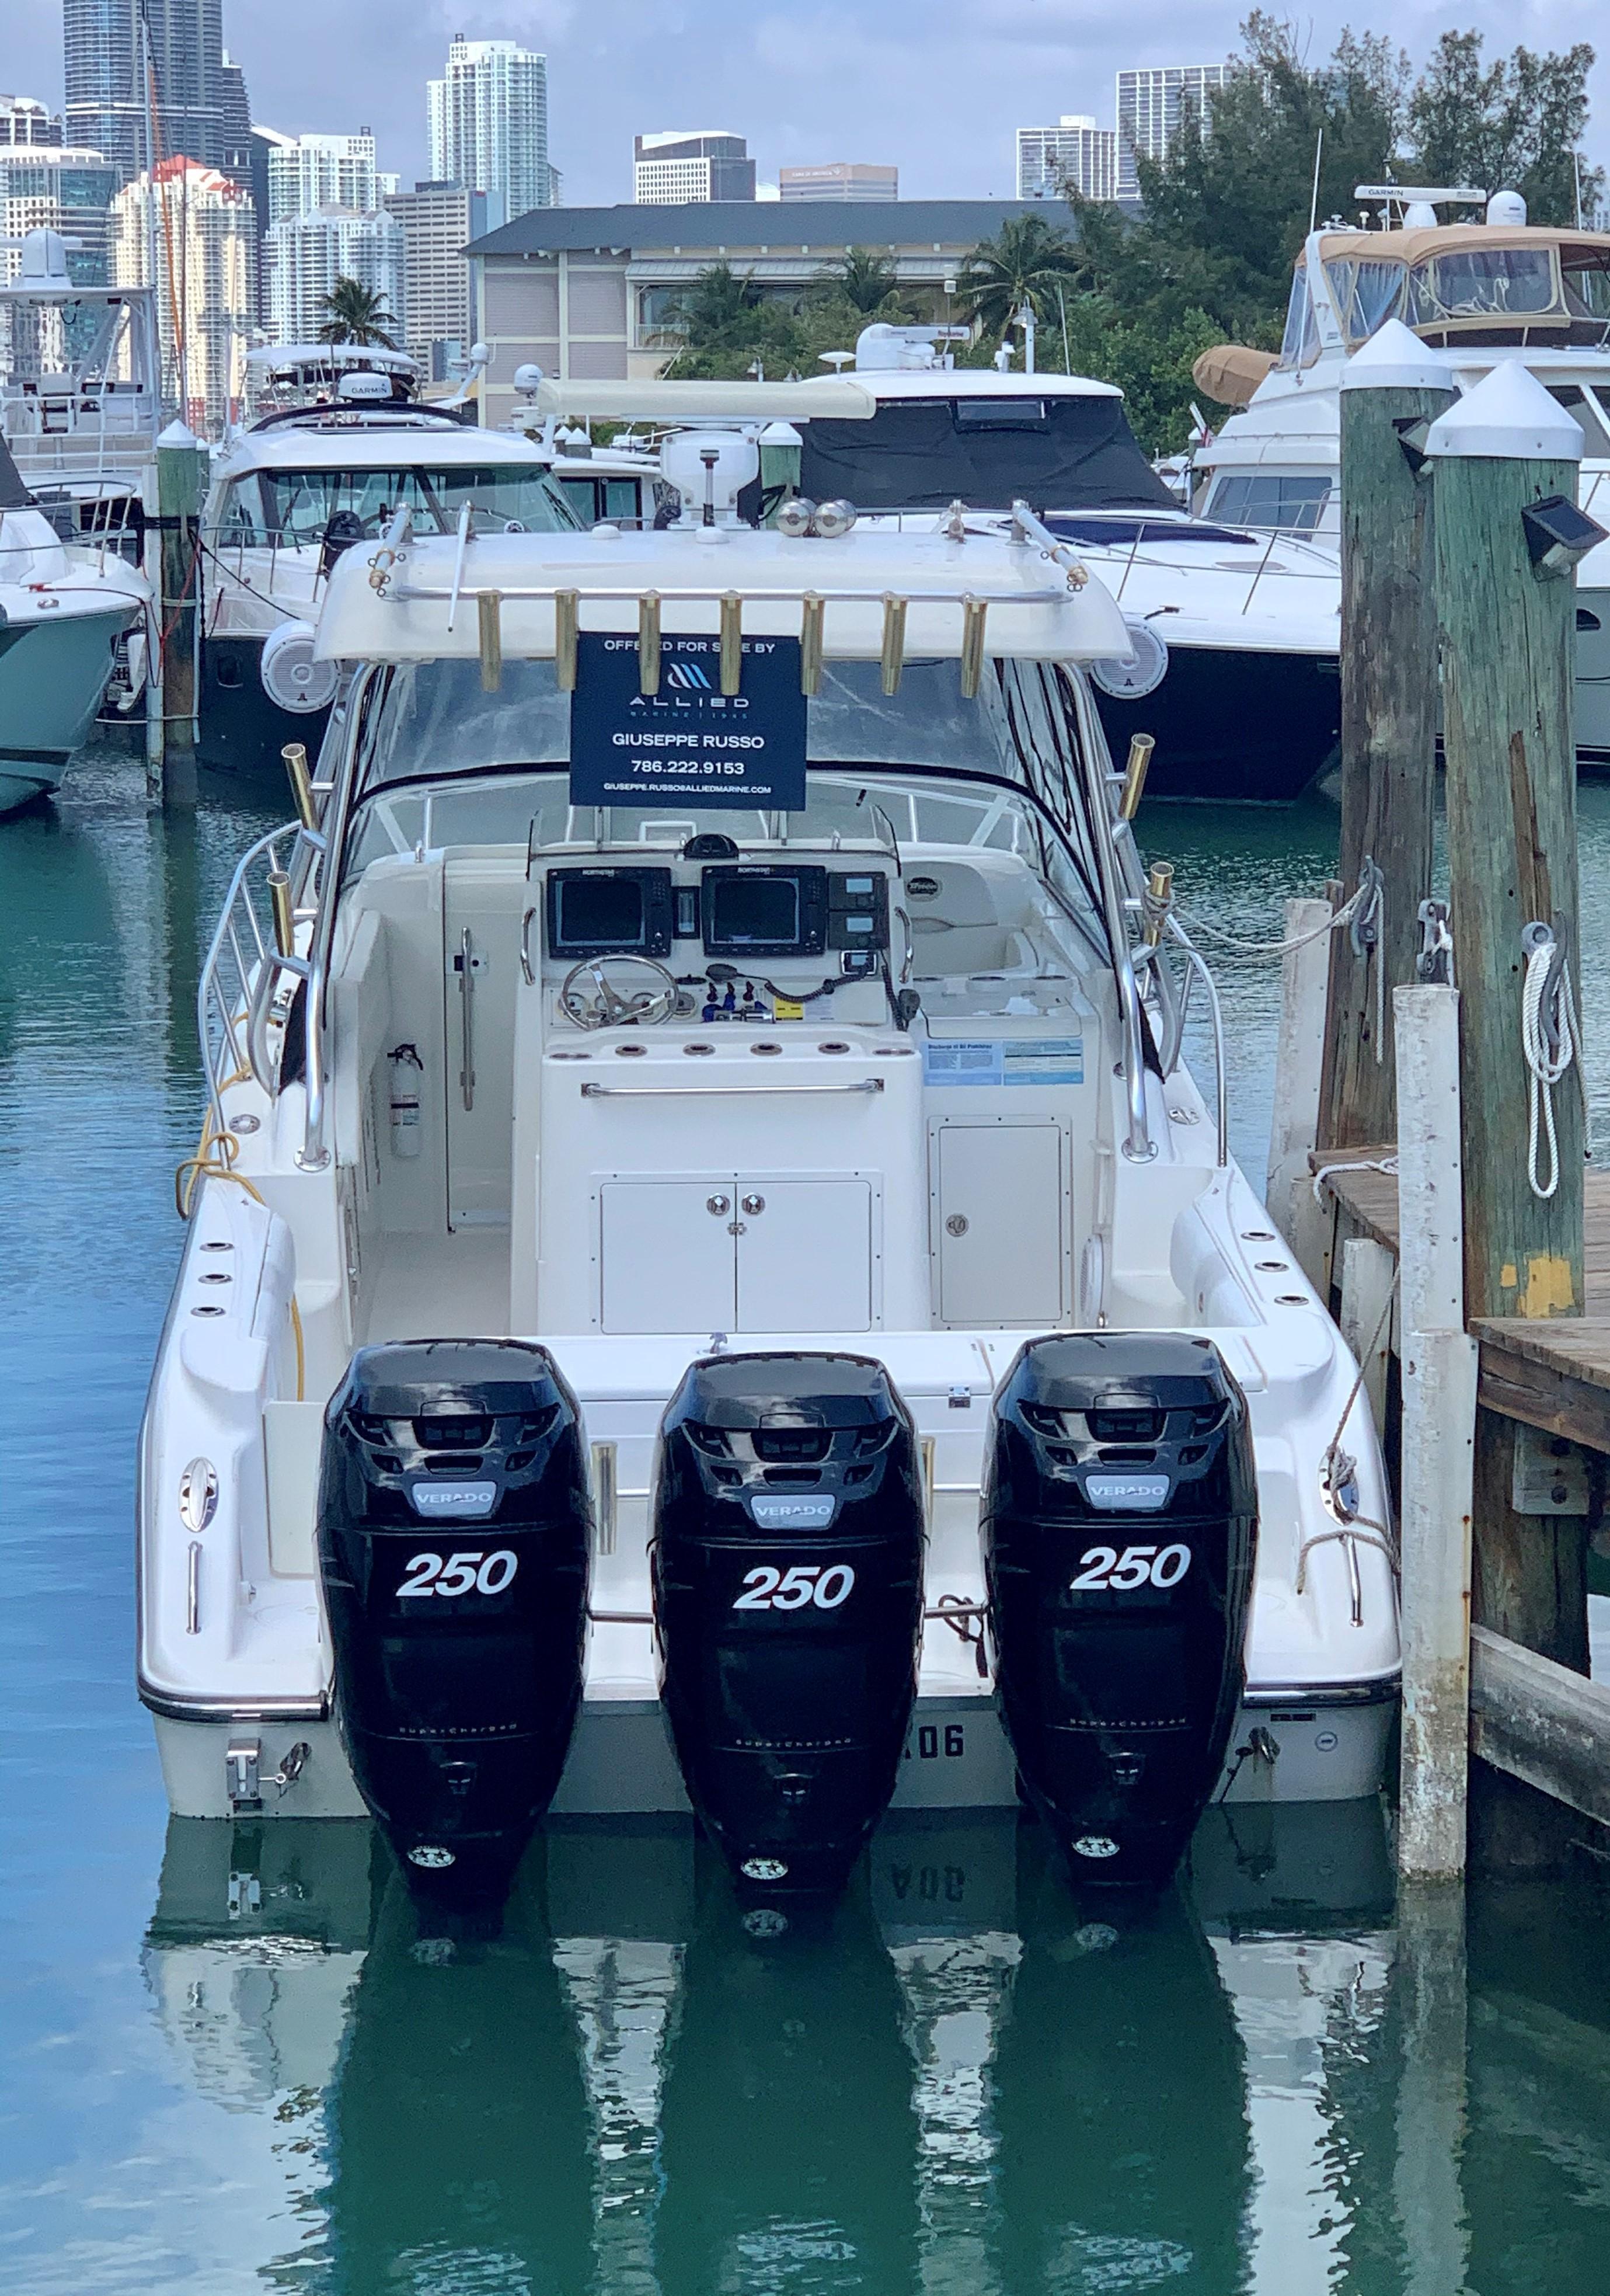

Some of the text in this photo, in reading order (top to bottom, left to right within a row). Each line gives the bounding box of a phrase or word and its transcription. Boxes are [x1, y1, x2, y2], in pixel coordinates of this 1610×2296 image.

[604, 640, 775, 653] OFFED FOR SE BY
[629, 696, 750, 708] ALLIED
[612, 733, 765, 749] GIUSEPPE RUSSO
[631, 760, 745, 775] 786.222.9153
[416, 1493, 492, 1503] VERADO
[1091, 1486, 1166, 1497] VERADO
[756, 1505, 832, 1516] VERADO
[396, 1550, 518, 1597] 250
[1069, 1544, 1192, 1590] 250
[732, 1564, 855, 1610] 250
[905, 1725, 964, 1759] 06
